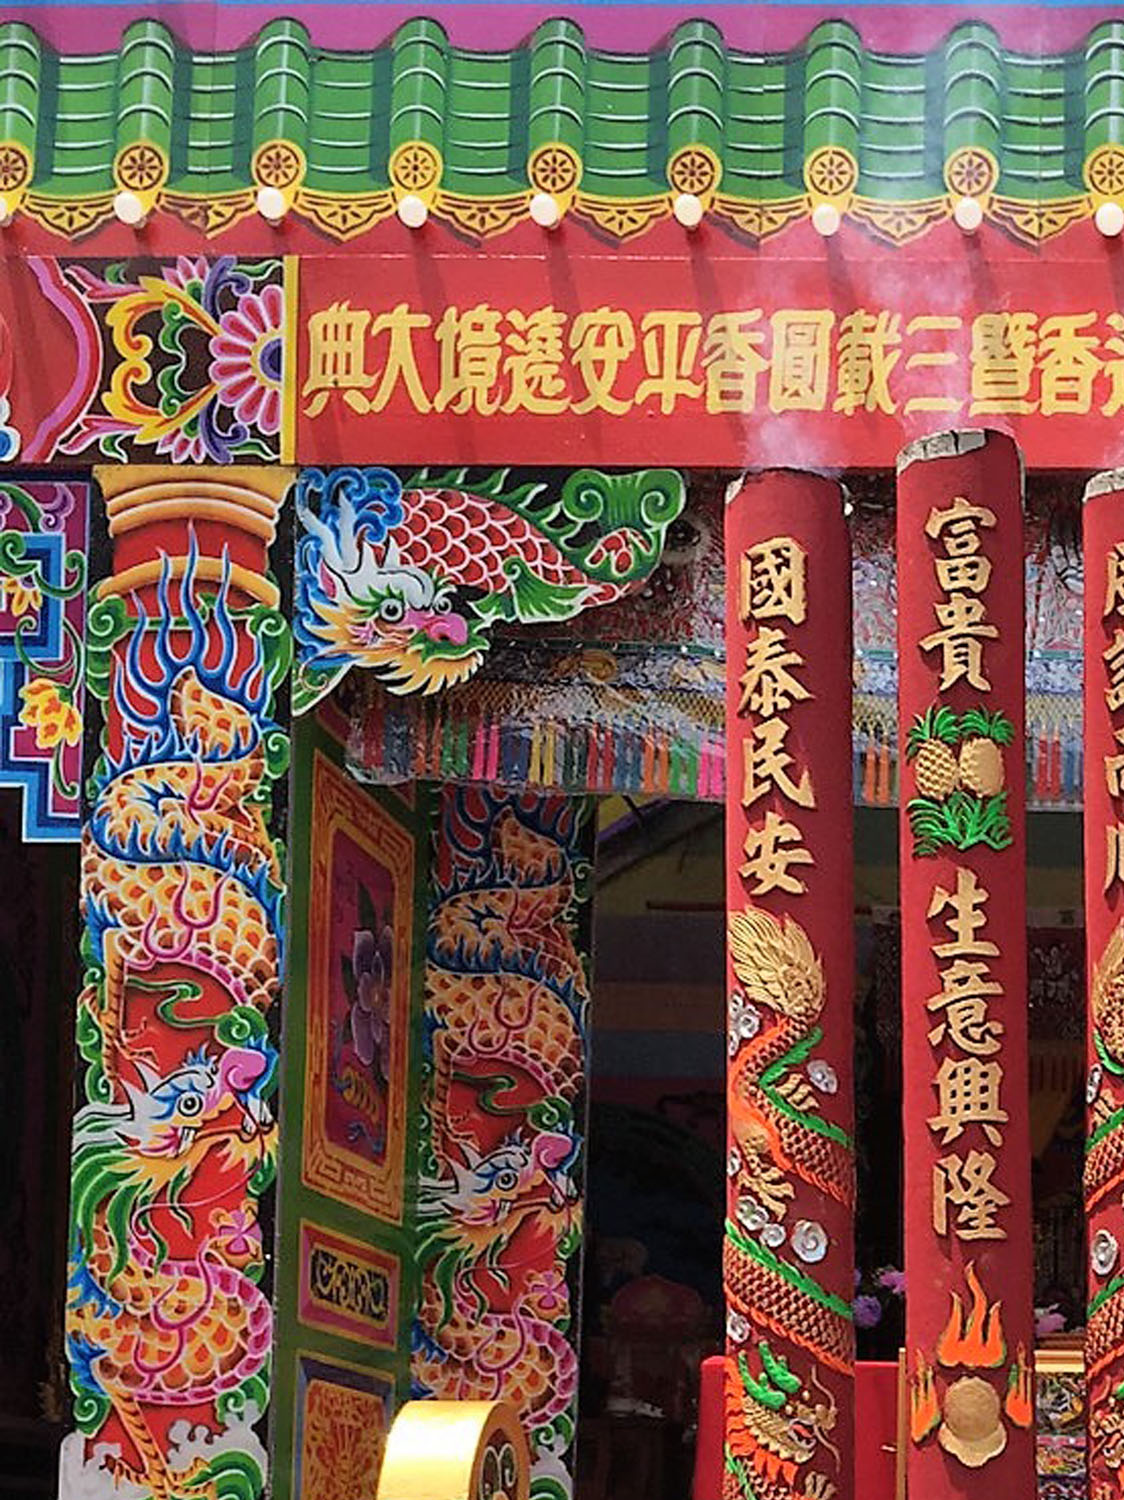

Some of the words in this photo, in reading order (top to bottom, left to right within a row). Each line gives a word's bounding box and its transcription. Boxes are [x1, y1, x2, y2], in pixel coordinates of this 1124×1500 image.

[738, 537, 816, 895] 國泰民安
[920, 498, 998, 692] 富貴
[926, 868, 1012, 1241] 生意興隆
